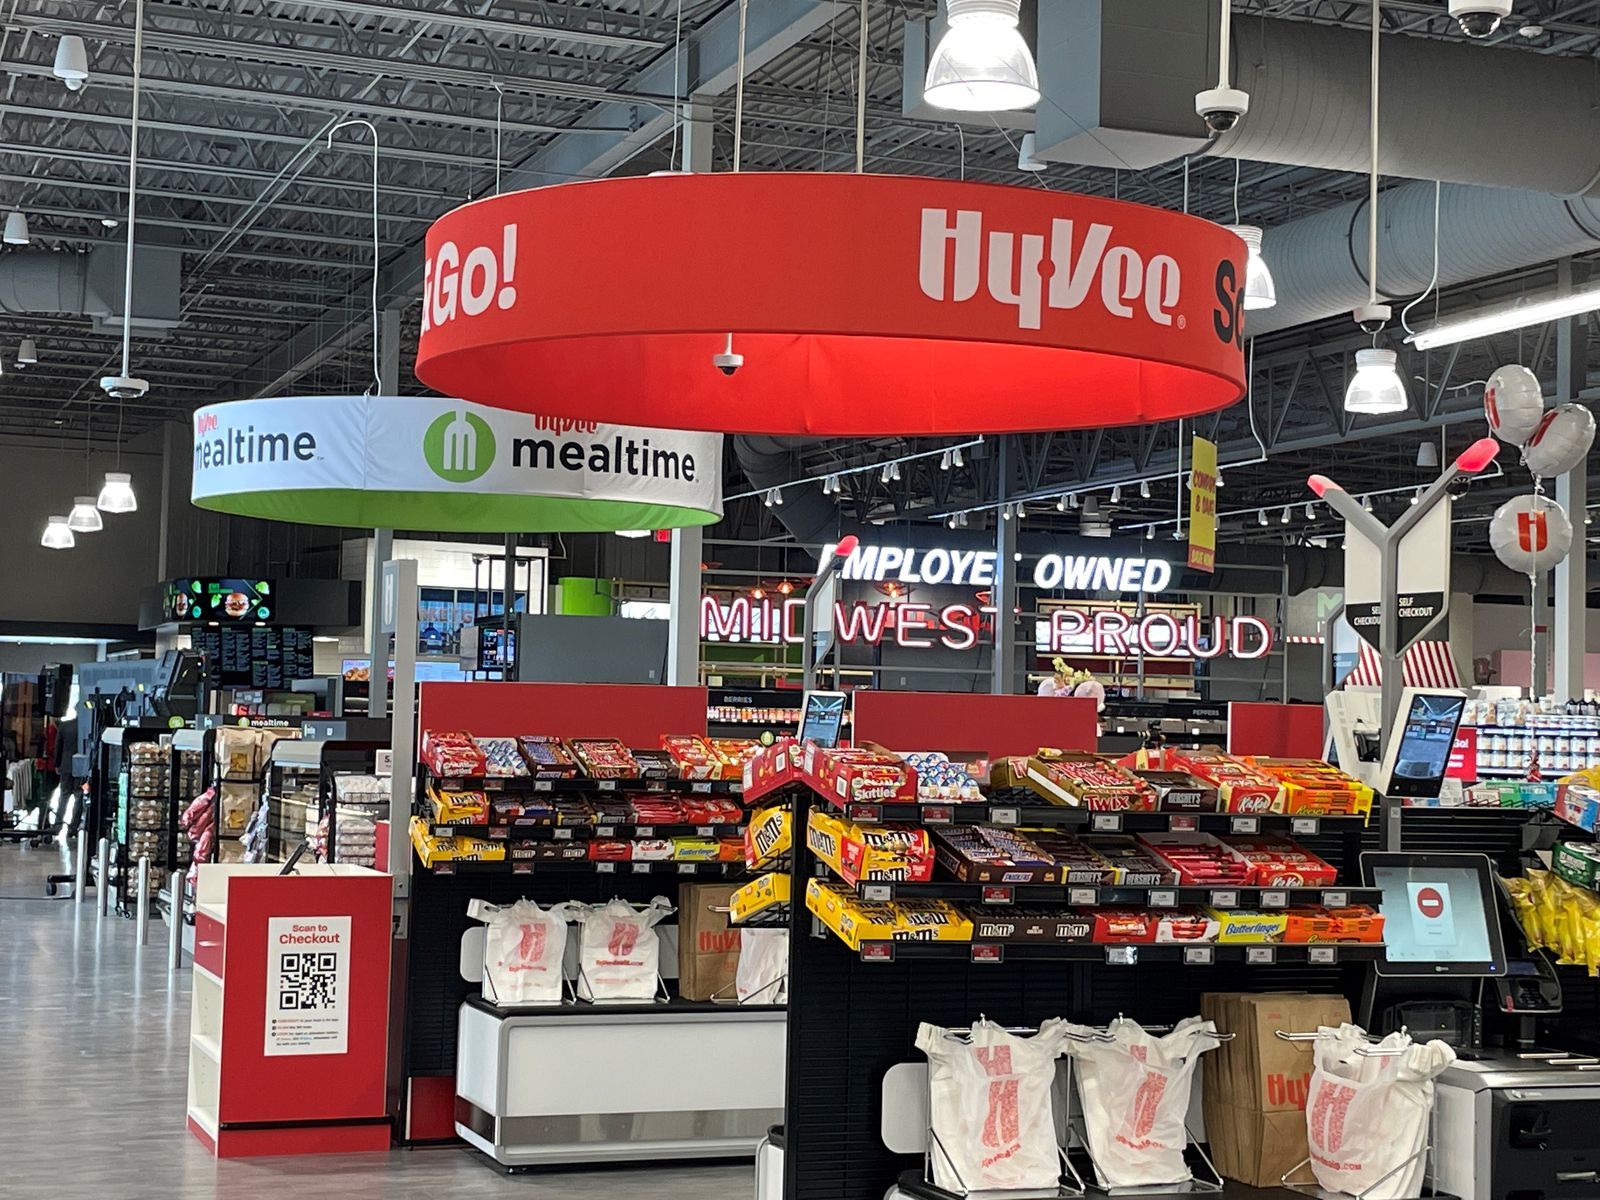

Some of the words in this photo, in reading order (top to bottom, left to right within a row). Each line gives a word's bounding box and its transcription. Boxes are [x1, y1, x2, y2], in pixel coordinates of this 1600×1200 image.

[512, 436, 696, 482] mealtime
[1033, 554, 1172, 593] OWNED
[1398, 597, 1413, 606] SELF
[1398, 607, 1433, 617] CHECKOUT
[1050, 609, 1273, 660] PROUD
[854, 787, 897, 802] Skittles
[292, 924, 316, 932] Scan
[318, 924, 328, 932] to
[1225, 923, 1281, 935] Butterfinger
[279, 933, 341, 945] Checkout
